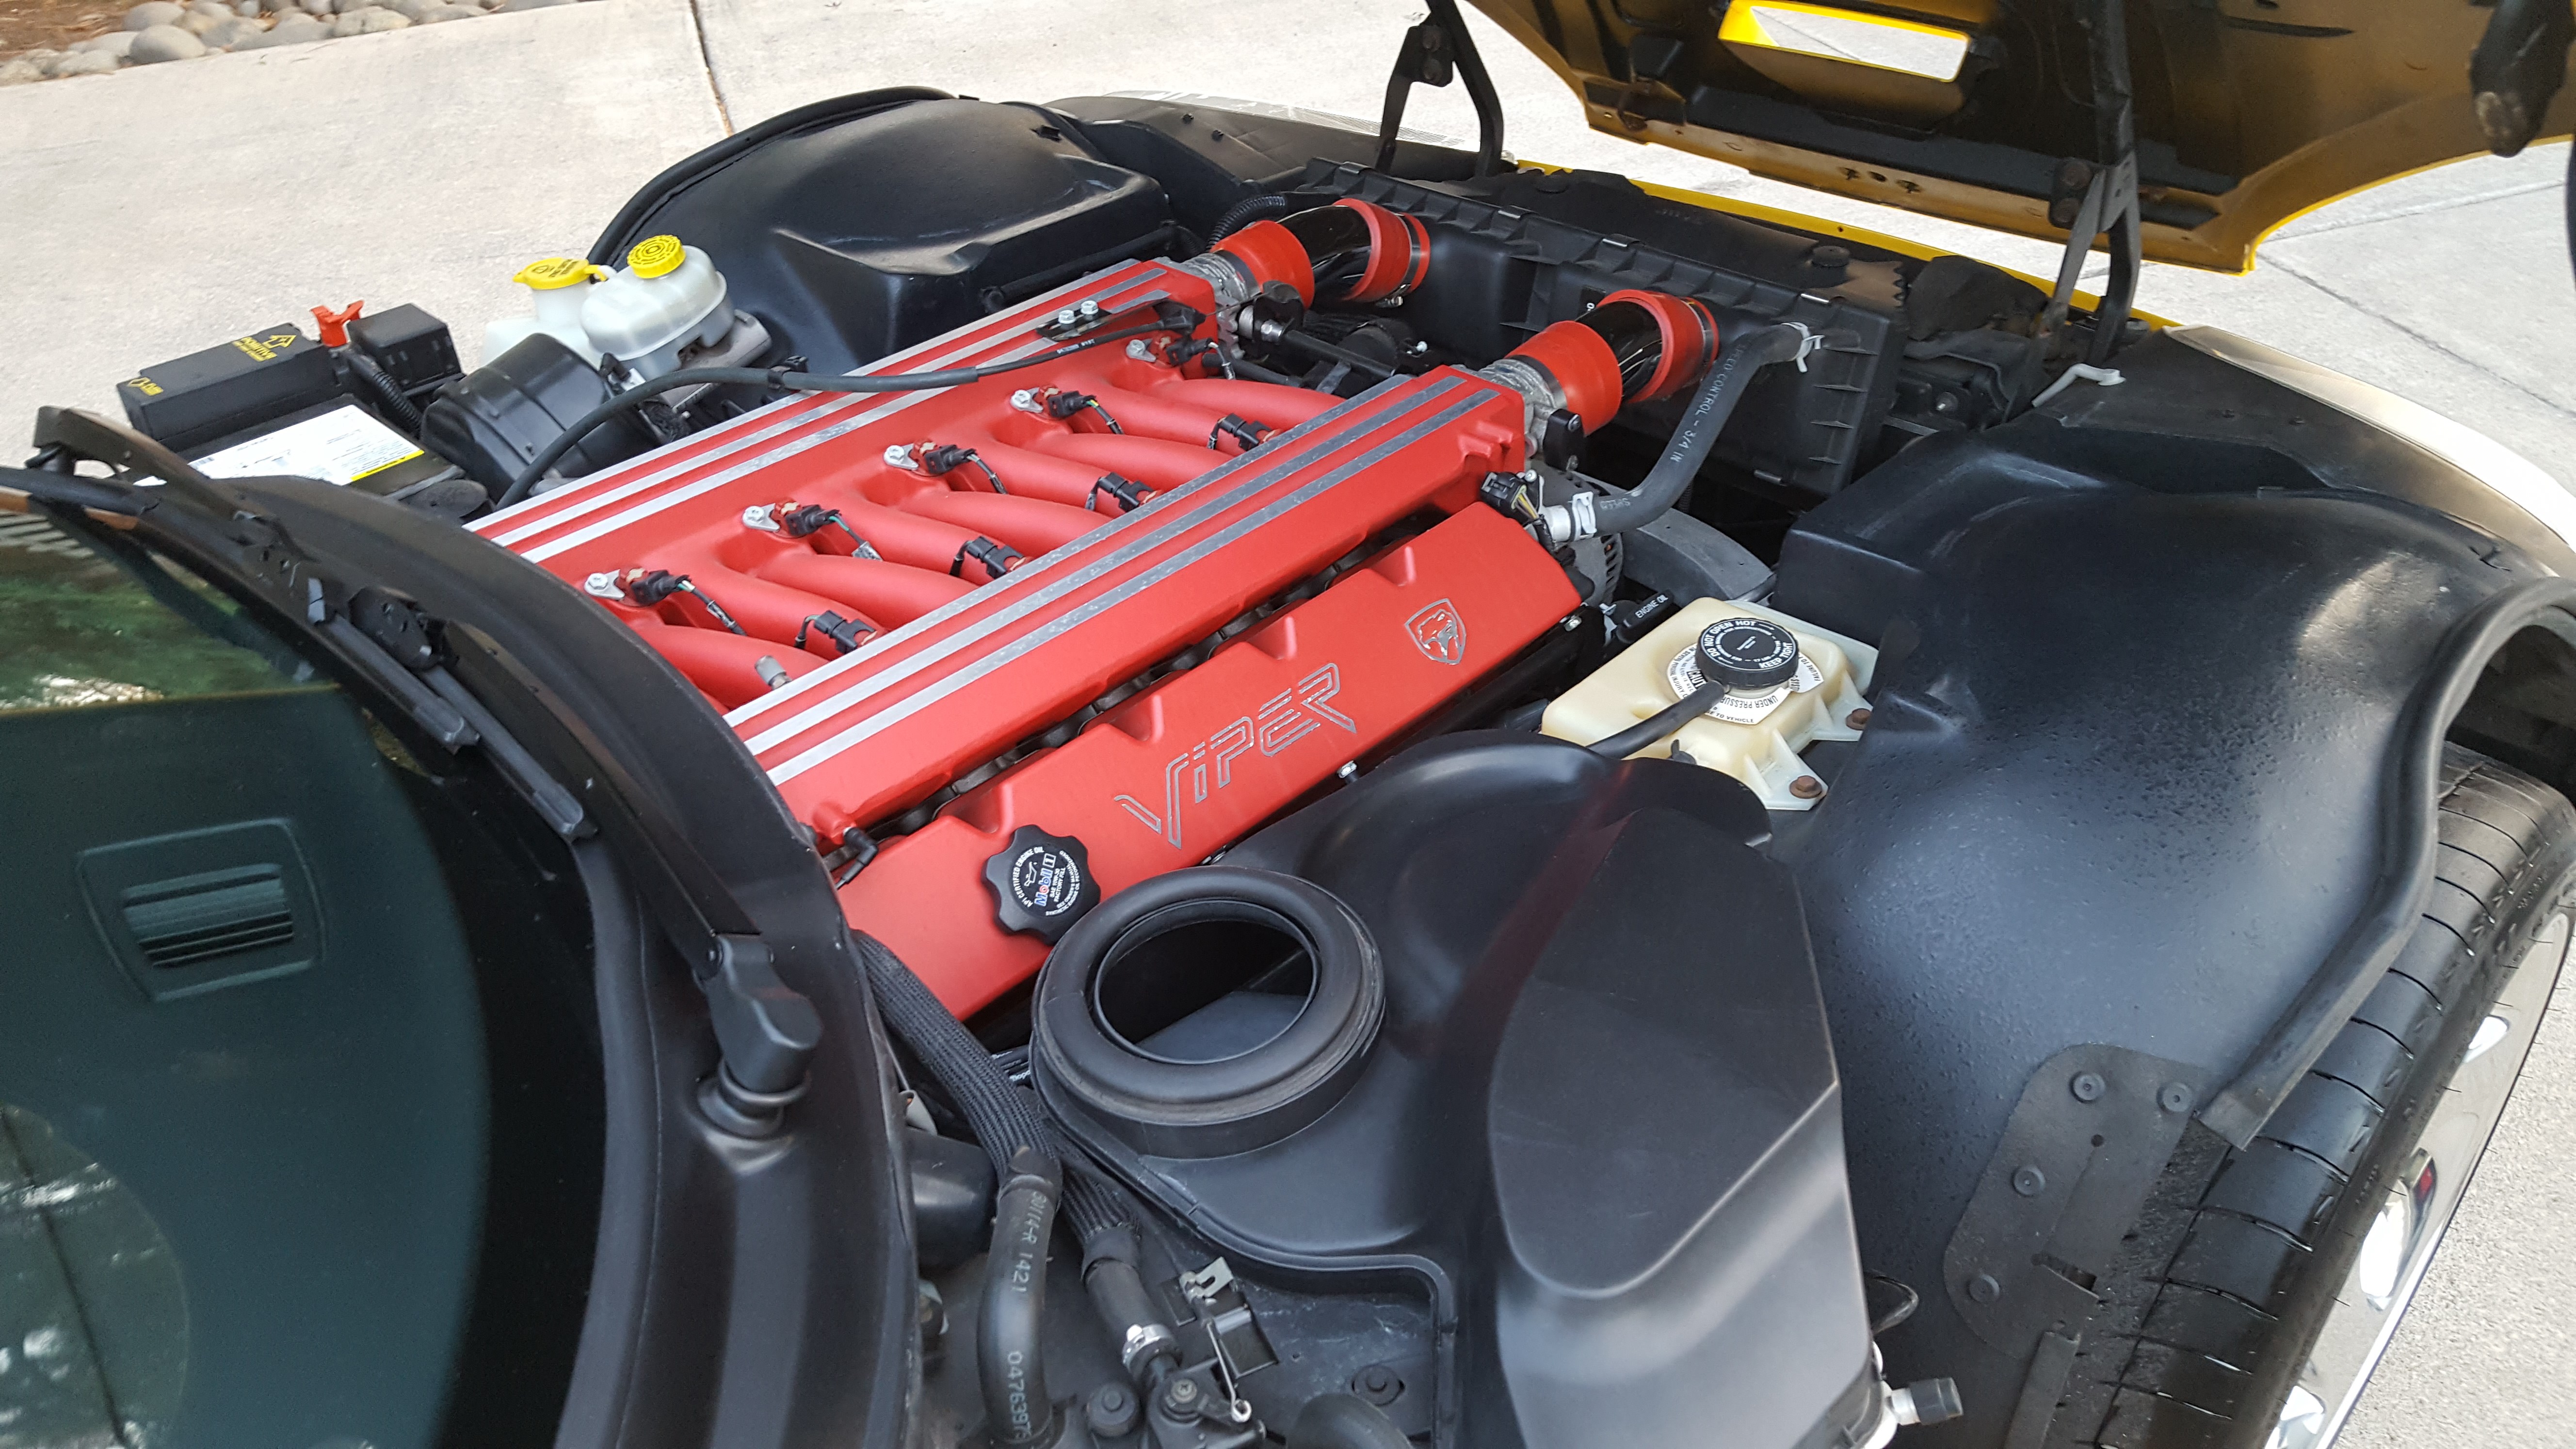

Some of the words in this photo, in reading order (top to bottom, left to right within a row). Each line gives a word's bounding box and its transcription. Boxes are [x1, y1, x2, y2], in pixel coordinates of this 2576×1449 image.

[1696, 373, 1726, 416] CONTROL
[1678, 429, 1697, 449] 3/4
[1670, 451, 1685, 463] IN
[1635, 599, 1659, 618] ENGINE
[1657, 594, 1669, 604] OIL
[1709, 622, 1734, 634] OPEN
[1704, 634, 1715, 646] NOT
[1706, 647, 1721, 657] DO
[1758, 657, 1783, 669] KEEP
[1778, 642, 1794, 658] TIGHT
[1687, 670, 1707, 688] CAUT
[1806, 664, 1821, 681] FAILURE
[1672, 676, 1686, 693] INJURY
[1720, 696, 1753, 708] PRESSUR
[1754, 695, 1779, 708] UNDER
[1114, 662, 1357, 850] VIPER
[1015, 849, 1034, 868] ENGINE
[1066, 862, 1076, 883] MANUAL
[1012, 867, 1025, 899] CERTIFIED
[1034, 868, 1054, 907] Mobil
[1053, 878, 1063, 902] FACTORY
[1022, 897, 1033, 907] API
